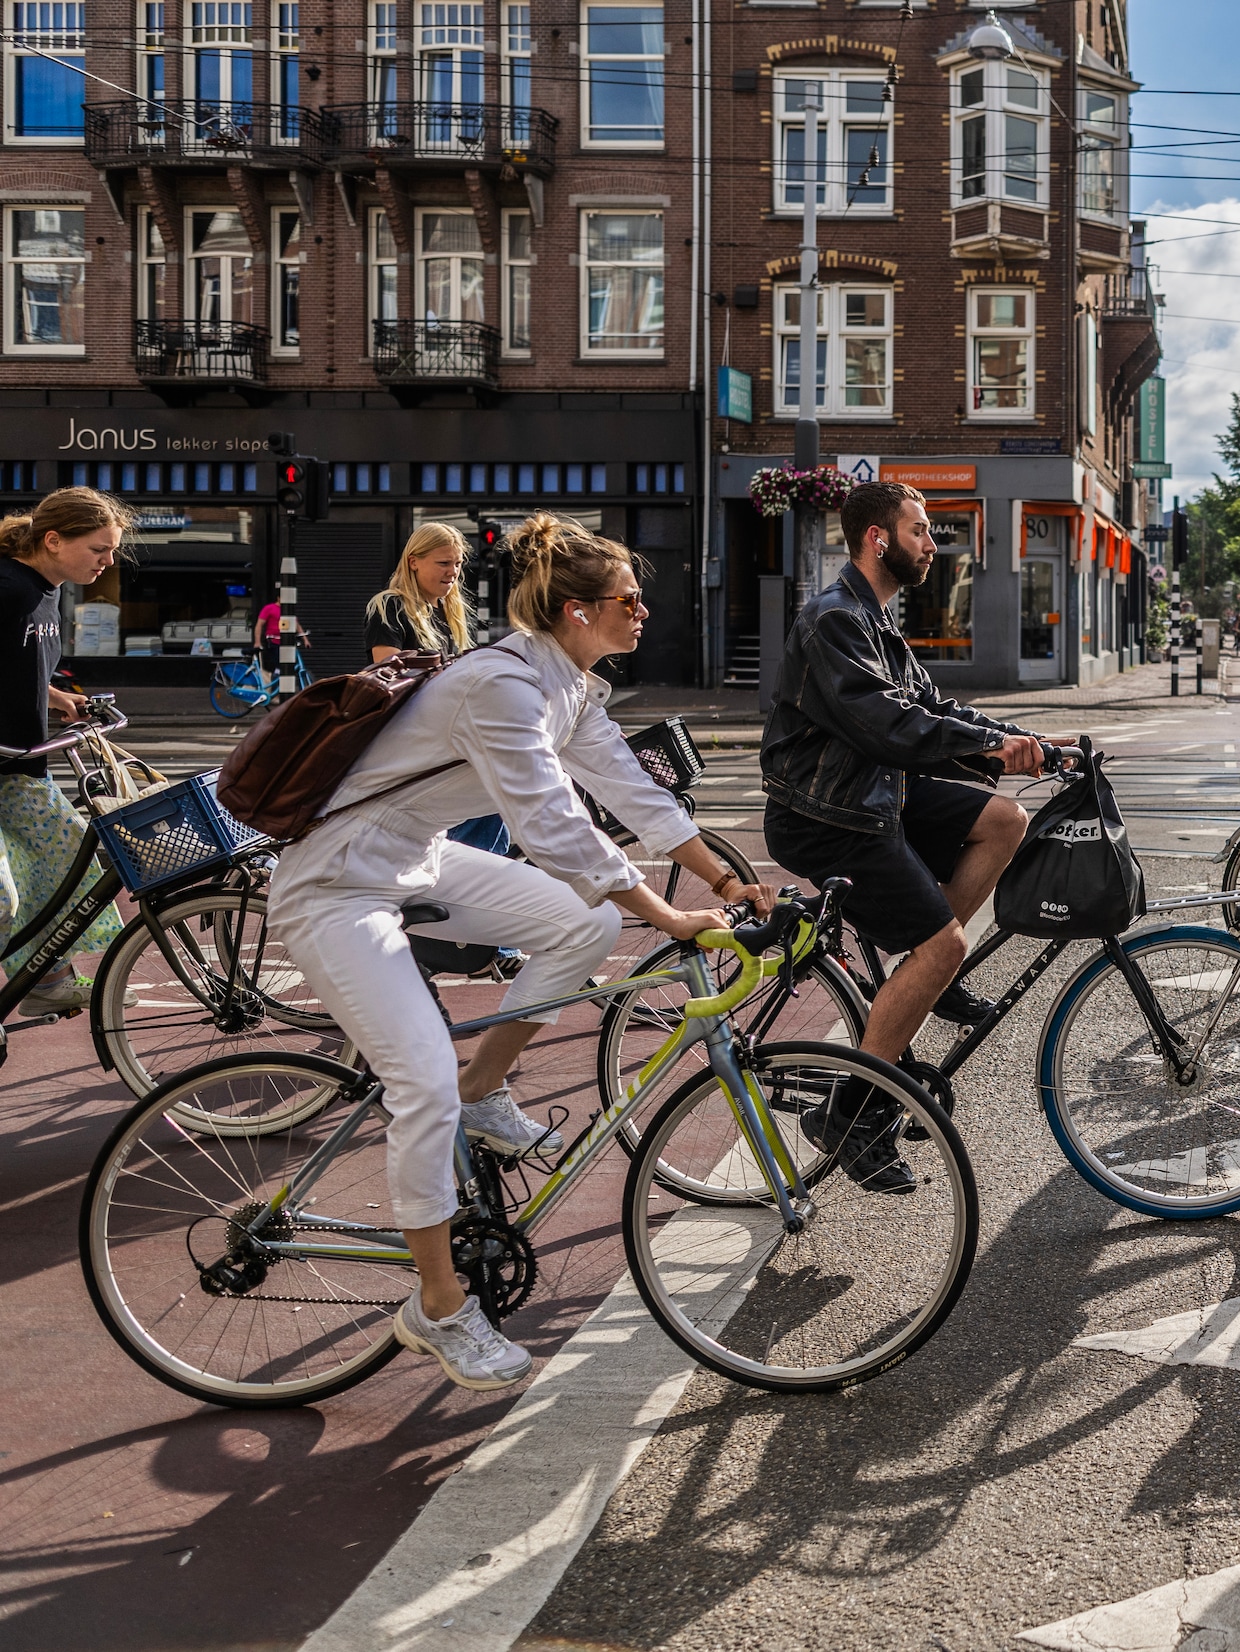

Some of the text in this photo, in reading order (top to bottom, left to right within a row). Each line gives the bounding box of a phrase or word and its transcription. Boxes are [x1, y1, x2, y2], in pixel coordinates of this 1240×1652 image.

[1147, 380, 1158, 461] HOSTEL
[58, 418, 270, 453] Janus lekker slape
[883, 473, 972, 481] DE HYPOTHEEKSHOP
[1026, 518, 1049, 538] 80
[26, 920, 79, 973] CORTINA
[636, 980, 656, 988] AVAIL
[1004, 954, 1048, 1005] SWAP
[880, 1351, 907, 1373] GIANT
